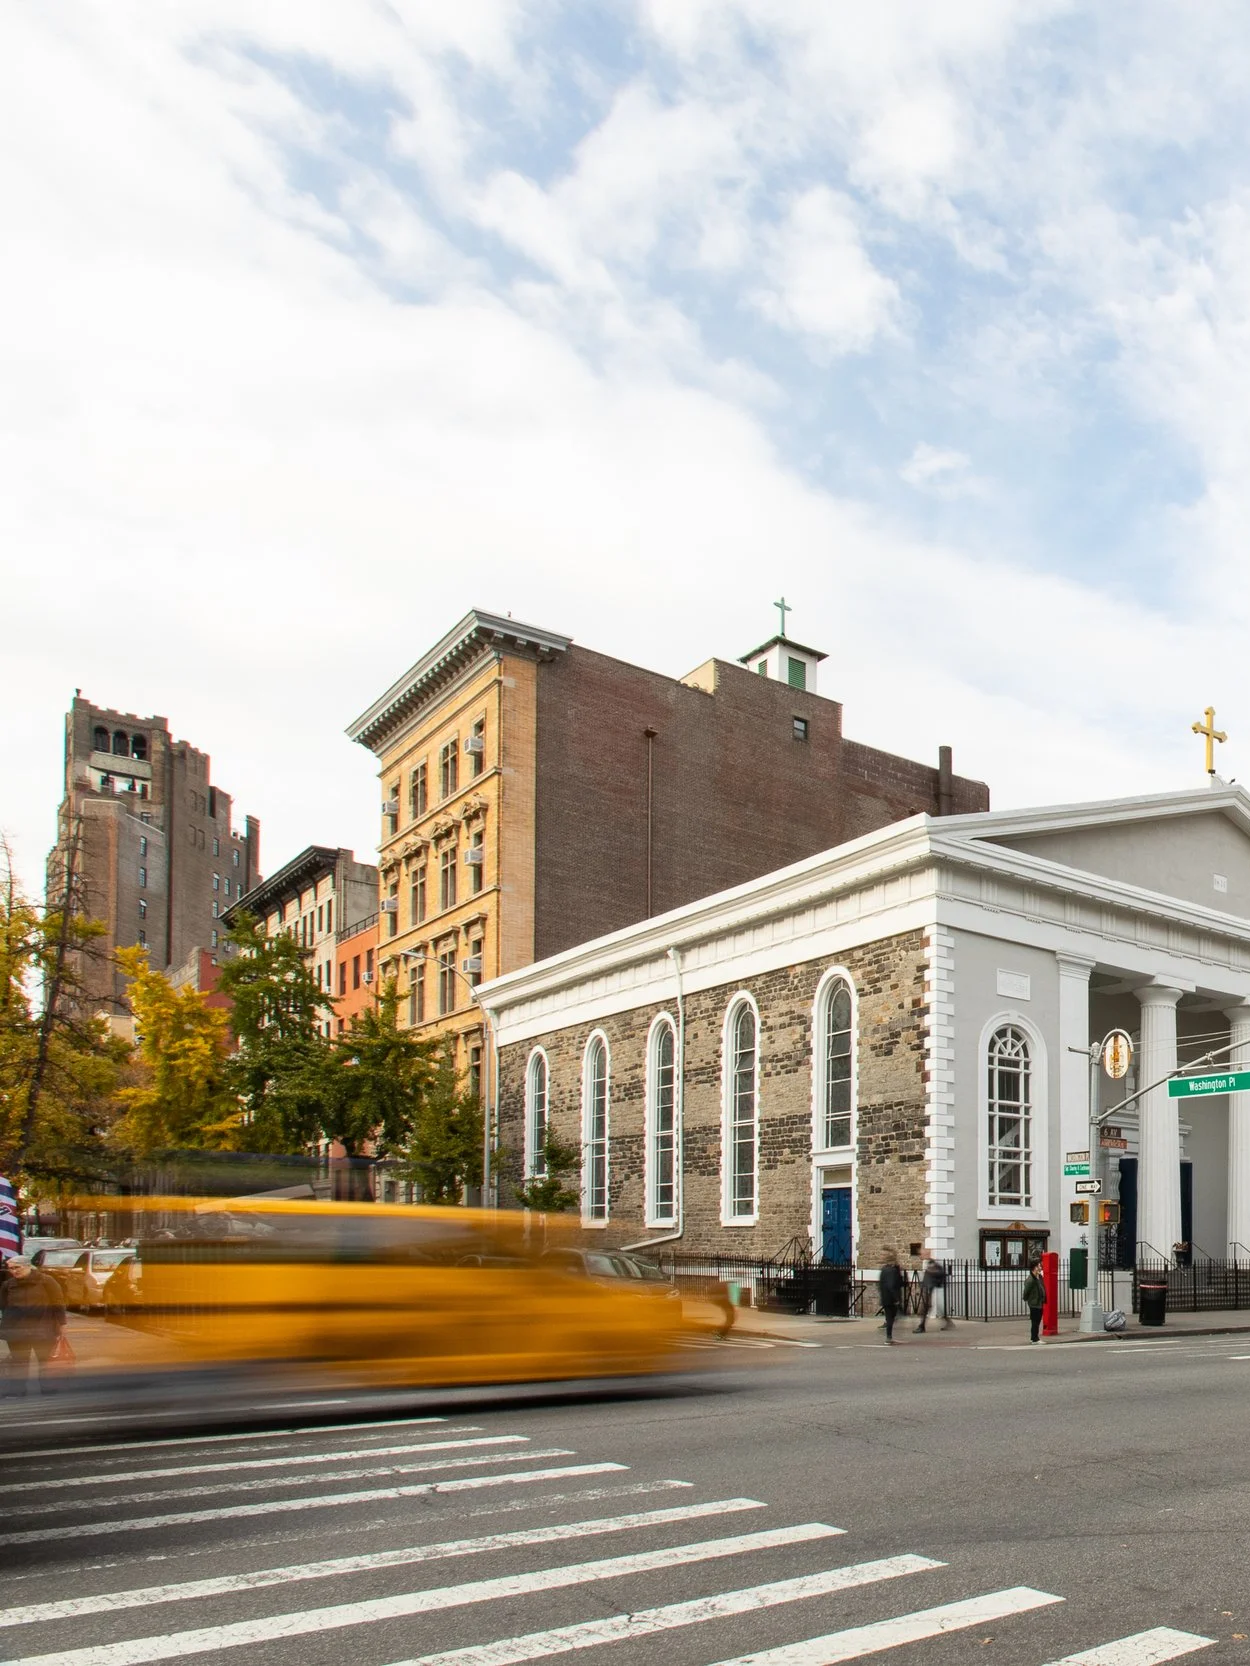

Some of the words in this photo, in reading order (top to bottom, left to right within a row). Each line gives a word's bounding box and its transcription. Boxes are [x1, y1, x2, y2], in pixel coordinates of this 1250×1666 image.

[1189, 1079, 1226, 1092] Washington
[1229, 1076, 1236, 1087] Pl
[1103, 1128, 1109, 1136] 6
